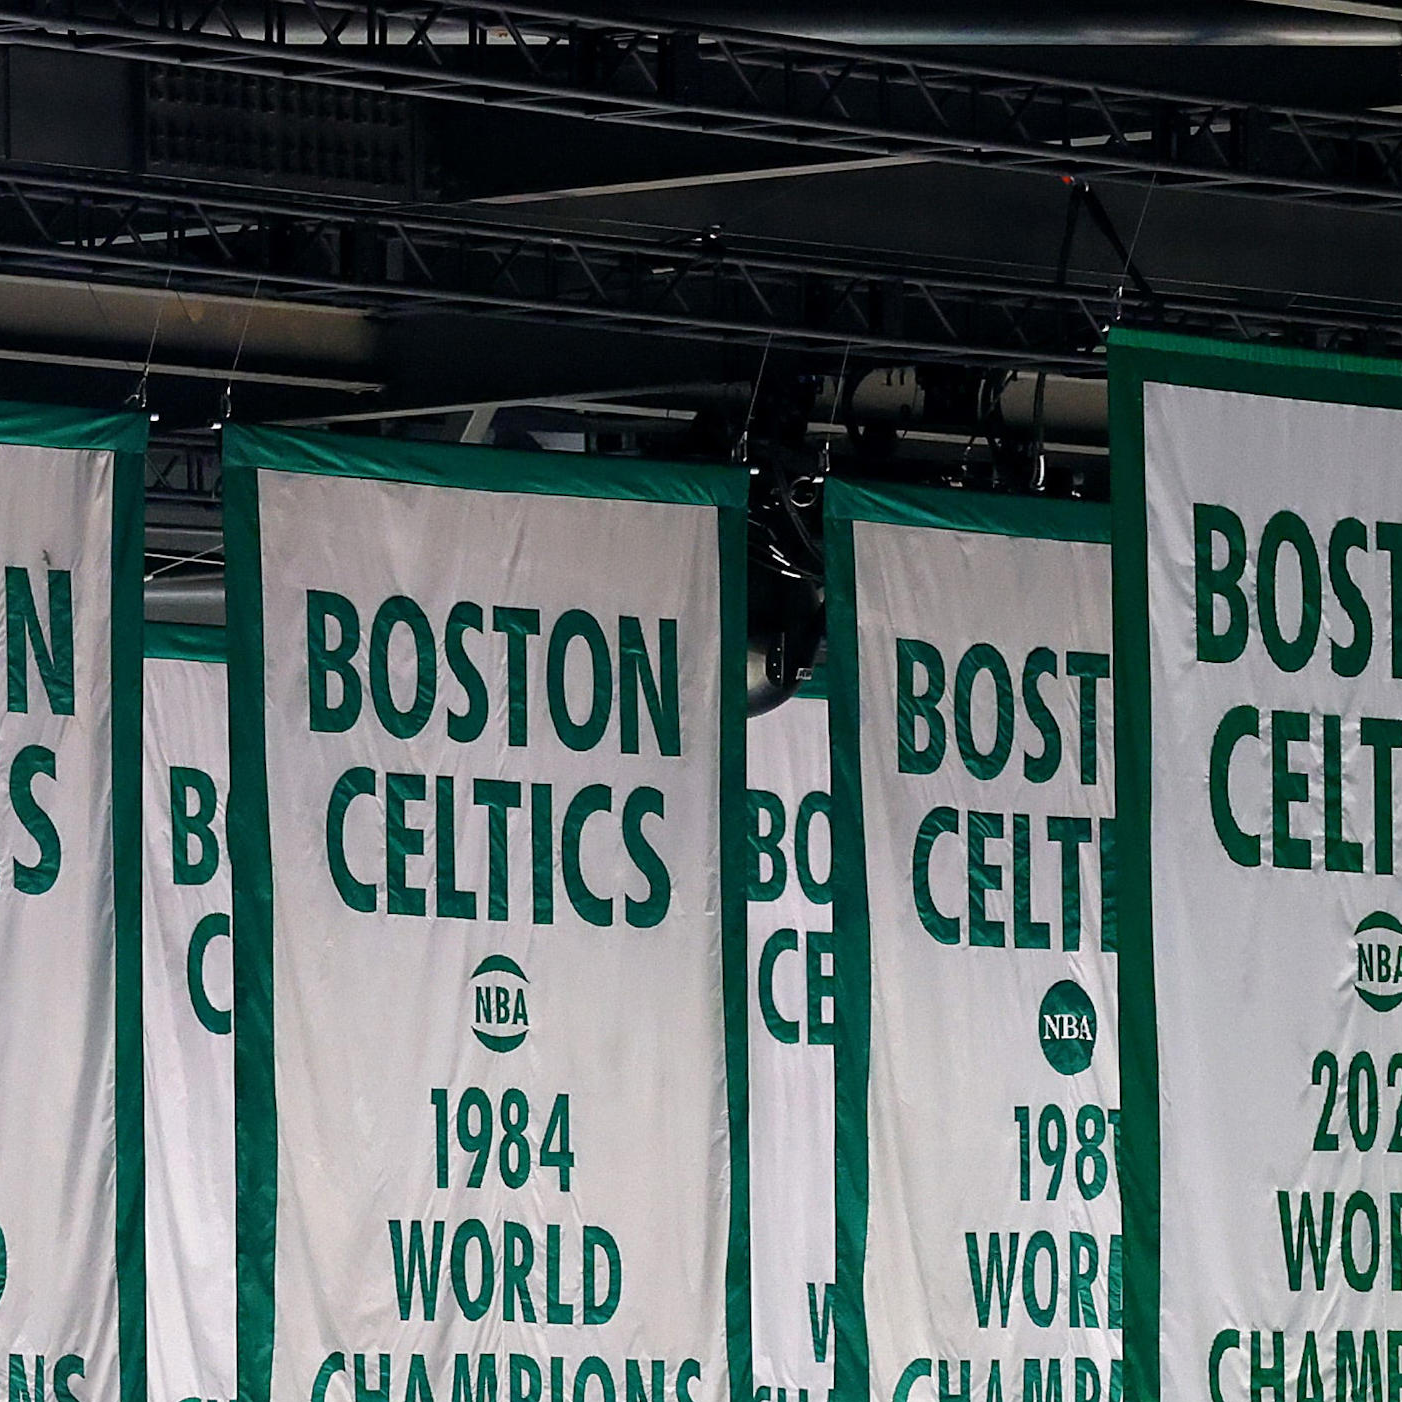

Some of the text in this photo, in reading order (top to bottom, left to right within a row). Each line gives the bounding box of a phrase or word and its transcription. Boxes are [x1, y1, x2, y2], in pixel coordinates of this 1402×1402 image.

[306, 589, 681, 757] BOSTON
[896, 637, 1110, 786] BOST
[325, 766, 671, 929] CELTICS
[912, 808, 1117, 953] CELTI
[475, 985, 529, 1026] NBA
[1043, 1014, 1093, 1041] NBA
[430, 1087, 575, 1193] 1984
[388, 1218, 622, 1326] WORLD
[965, 1230, 1122, 1330] WORL
